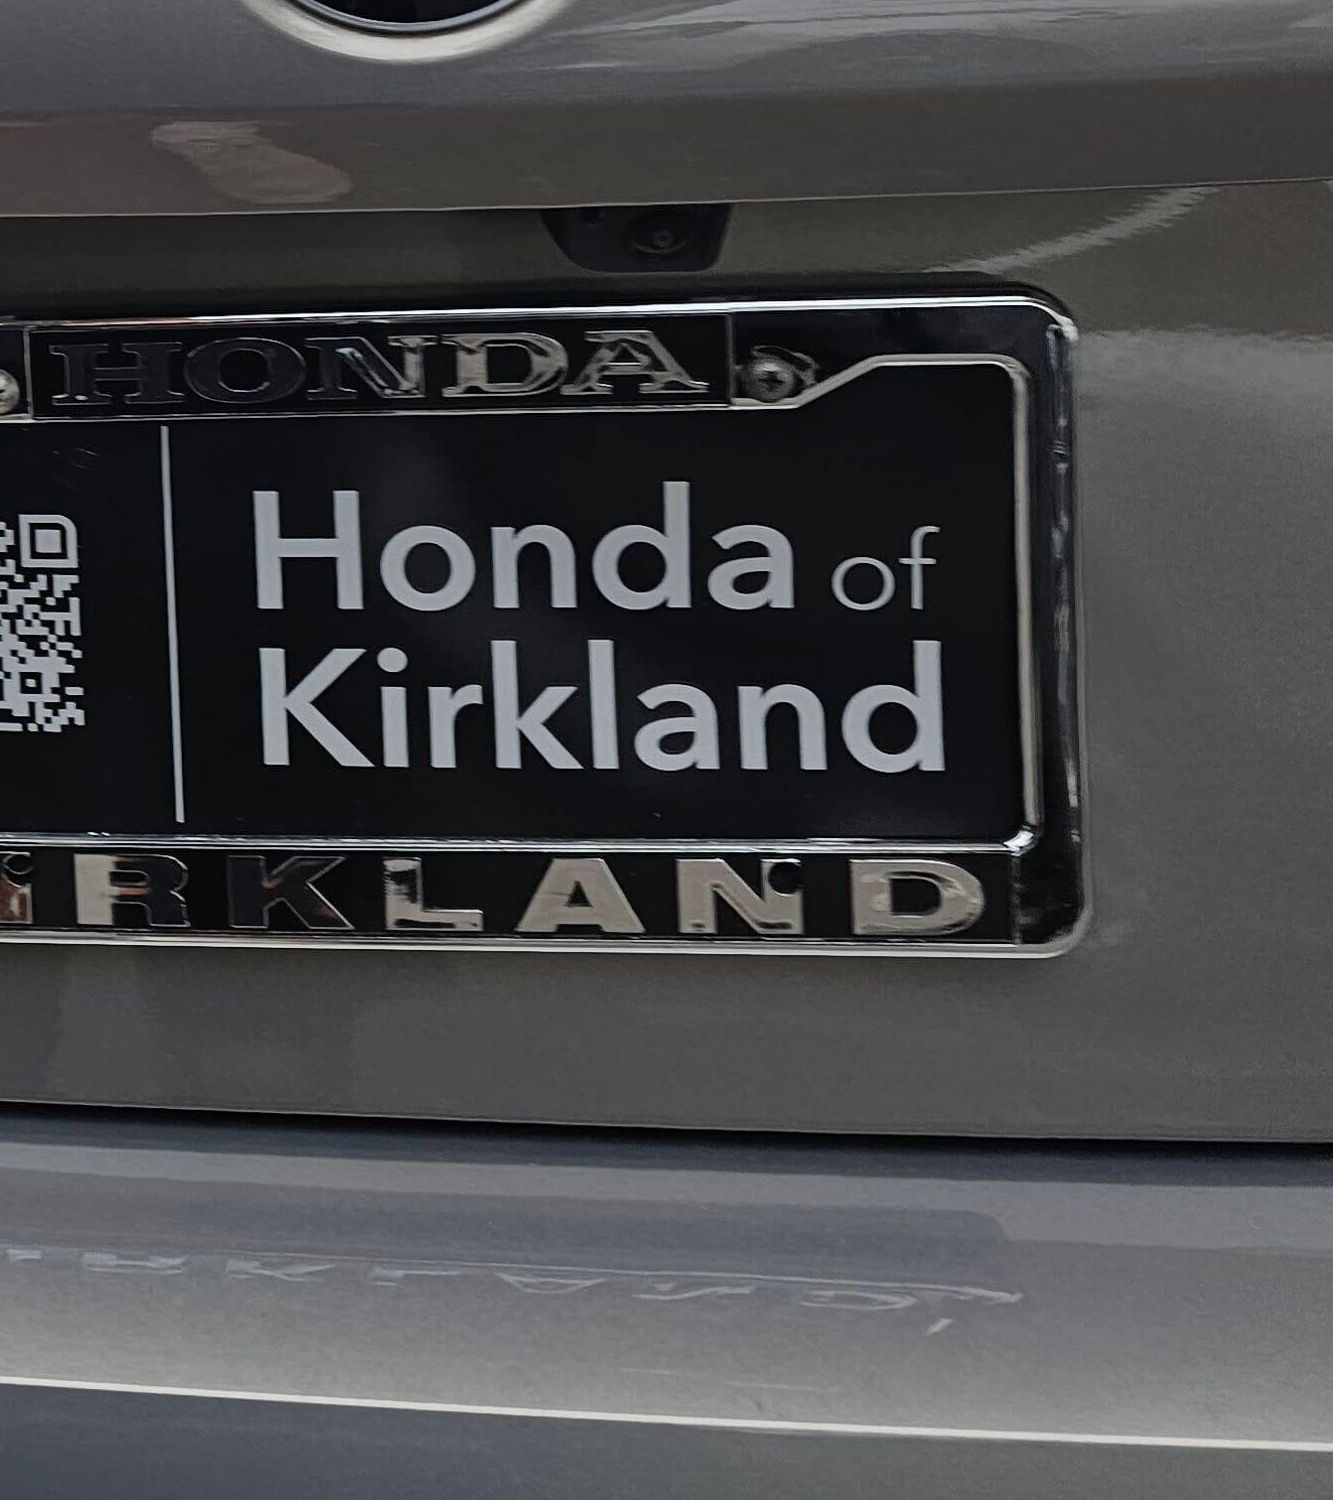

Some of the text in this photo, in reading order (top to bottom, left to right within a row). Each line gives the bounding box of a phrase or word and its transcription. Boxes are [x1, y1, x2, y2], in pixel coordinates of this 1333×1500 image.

[49, 330, 710, 405] HONDA
[252, 481, 941, 611] Honda of
[259, 639, 946, 774] Kirkland
